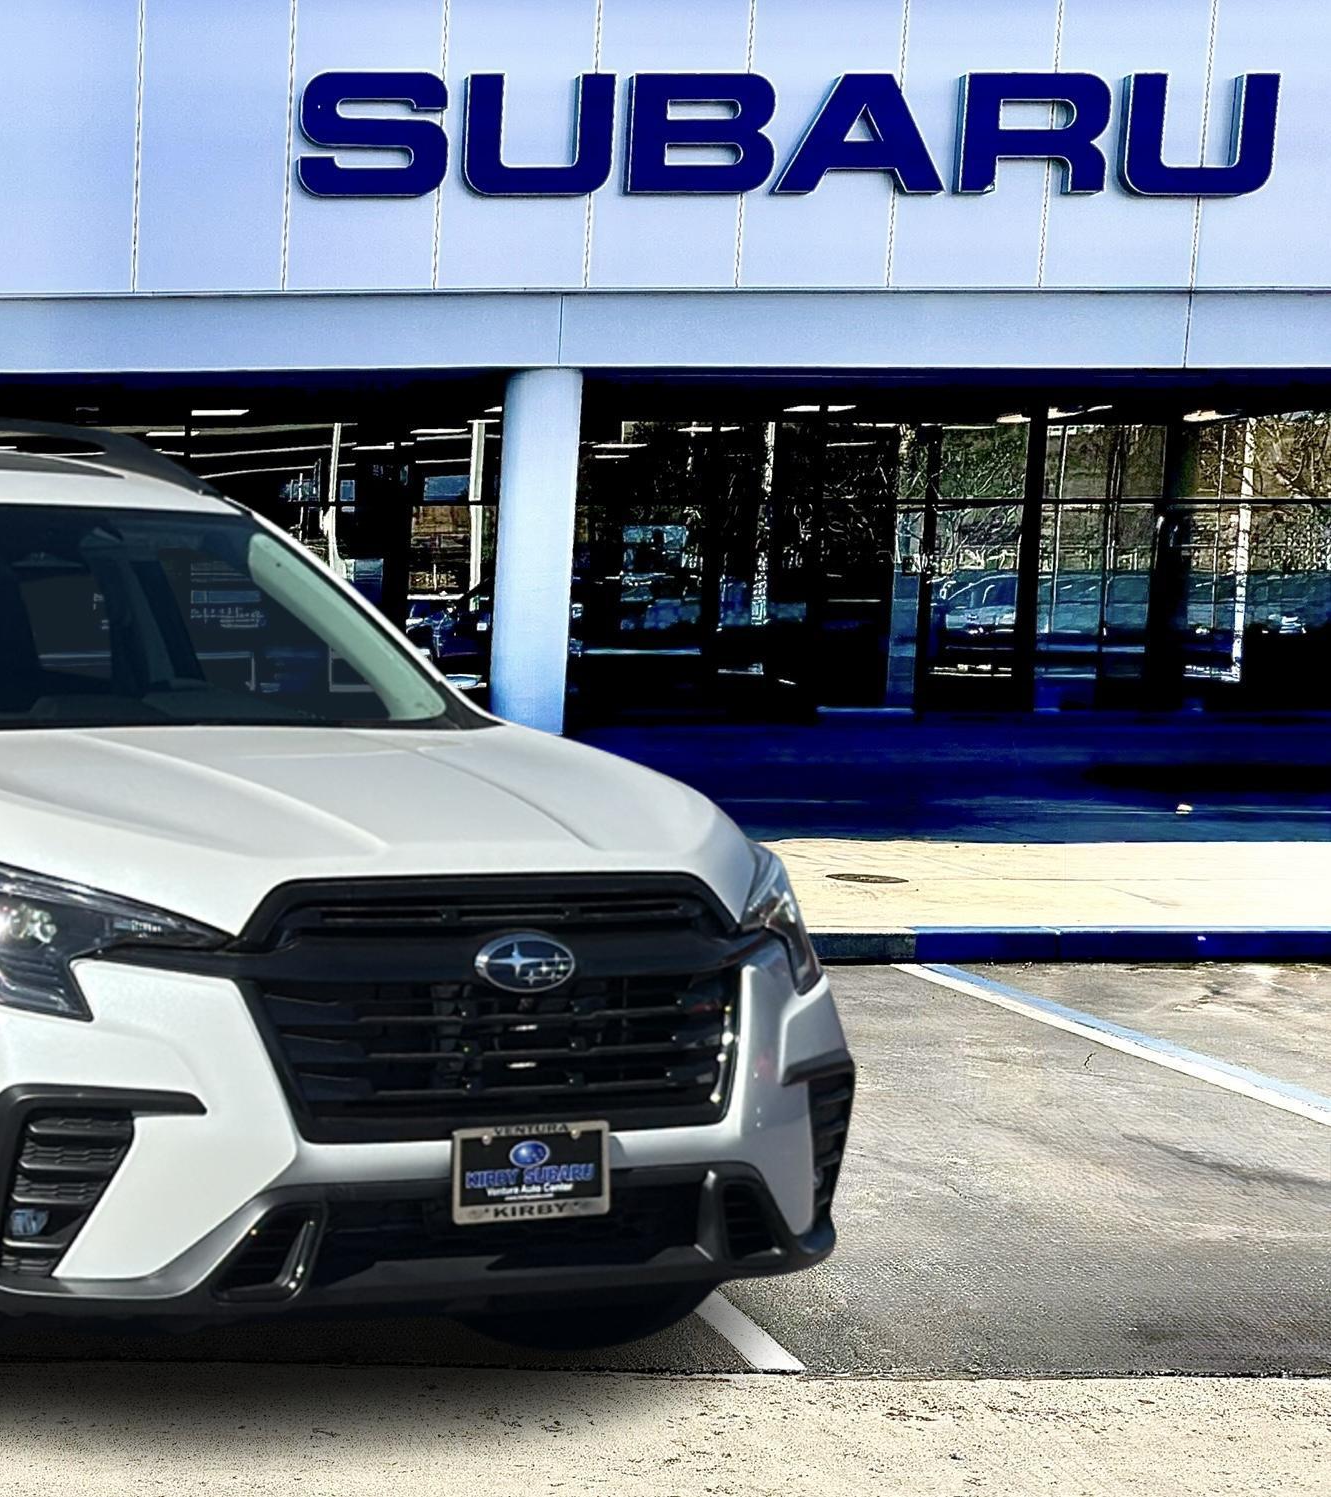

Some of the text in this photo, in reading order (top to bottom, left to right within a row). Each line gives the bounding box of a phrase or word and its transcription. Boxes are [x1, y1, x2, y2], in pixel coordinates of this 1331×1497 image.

[296, 70, 1281, 199] SUBARU
[493, 1123, 569, 1136] VENTURA
[465, 1164, 594, 1189] KIRBY SUBARU
[487, 1182, 573, 1196] Ventura Auto Center
[493, 1202, 567, 1218] KIRBY
